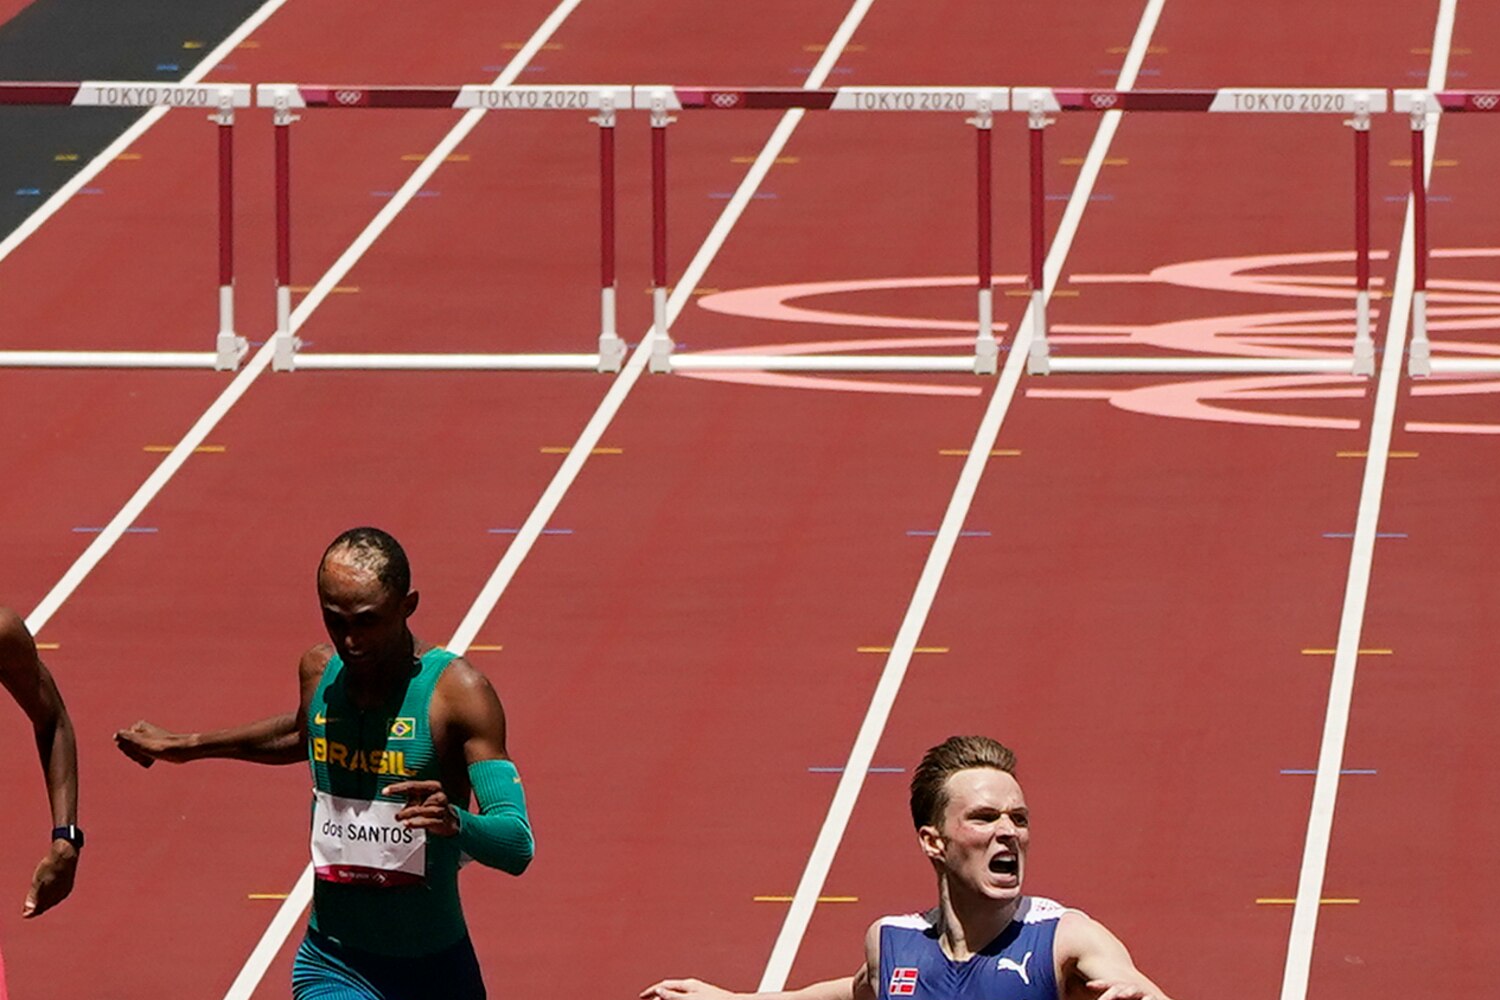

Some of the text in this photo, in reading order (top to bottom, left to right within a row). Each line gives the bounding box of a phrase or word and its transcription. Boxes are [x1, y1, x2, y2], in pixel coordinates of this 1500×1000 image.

[95, 87, 208, 105] TOKYO 2020
[476, 90, 589, 108] TOKYO 2020
[853, 91, 966, 109] TOKYO 2020
[1233, 93, 1345, 110] TOKYO 2020
[312, 737, 418, 777] BRASIL
[322, 818, 413, 845] dos SANTOS
